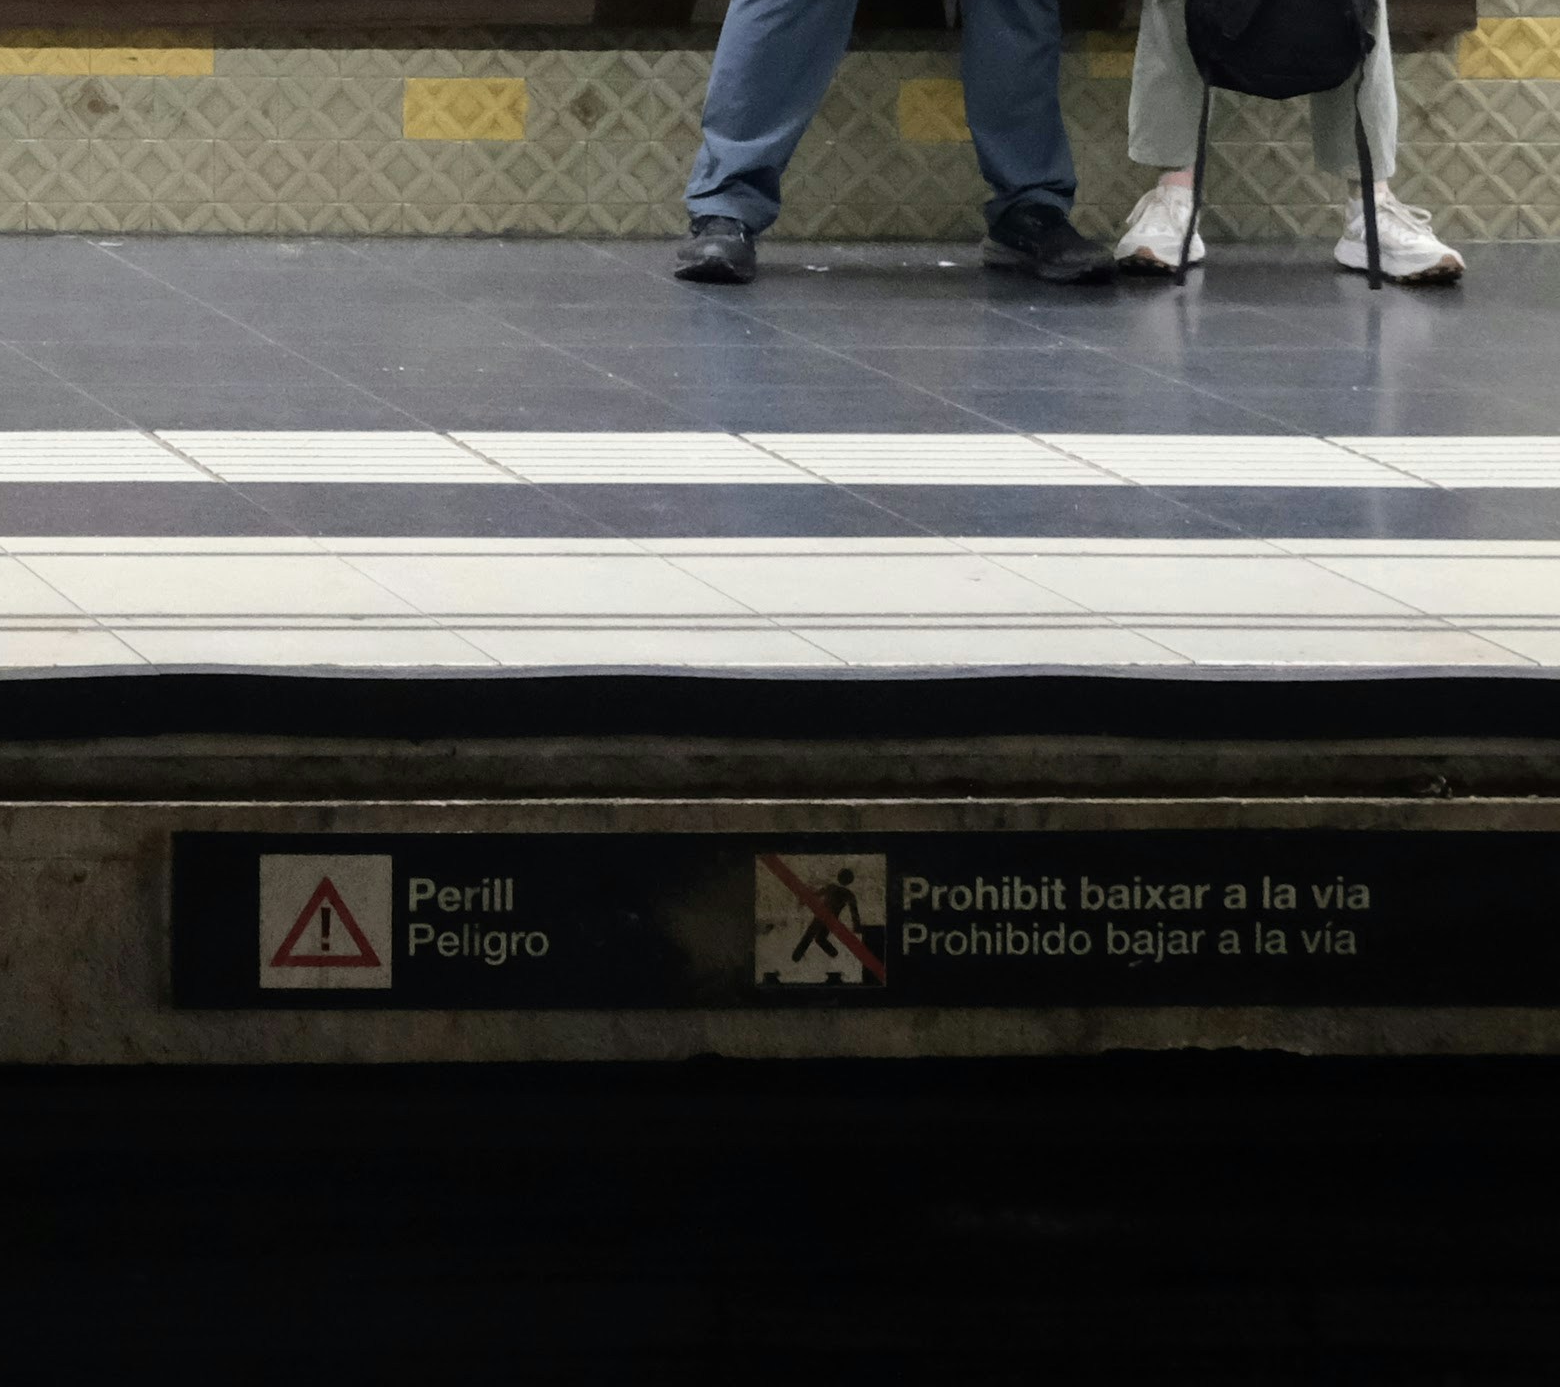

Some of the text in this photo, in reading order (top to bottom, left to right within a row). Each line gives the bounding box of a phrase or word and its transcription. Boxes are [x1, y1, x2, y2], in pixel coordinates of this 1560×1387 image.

[409, 878, 513, 911] Perill
[903, 876, 1370, 911] Prohibit baixar a la via
[409, 923, 549, 966] Peligro
[903, 922, 1356, 962] Prohibido bajar a la vía
